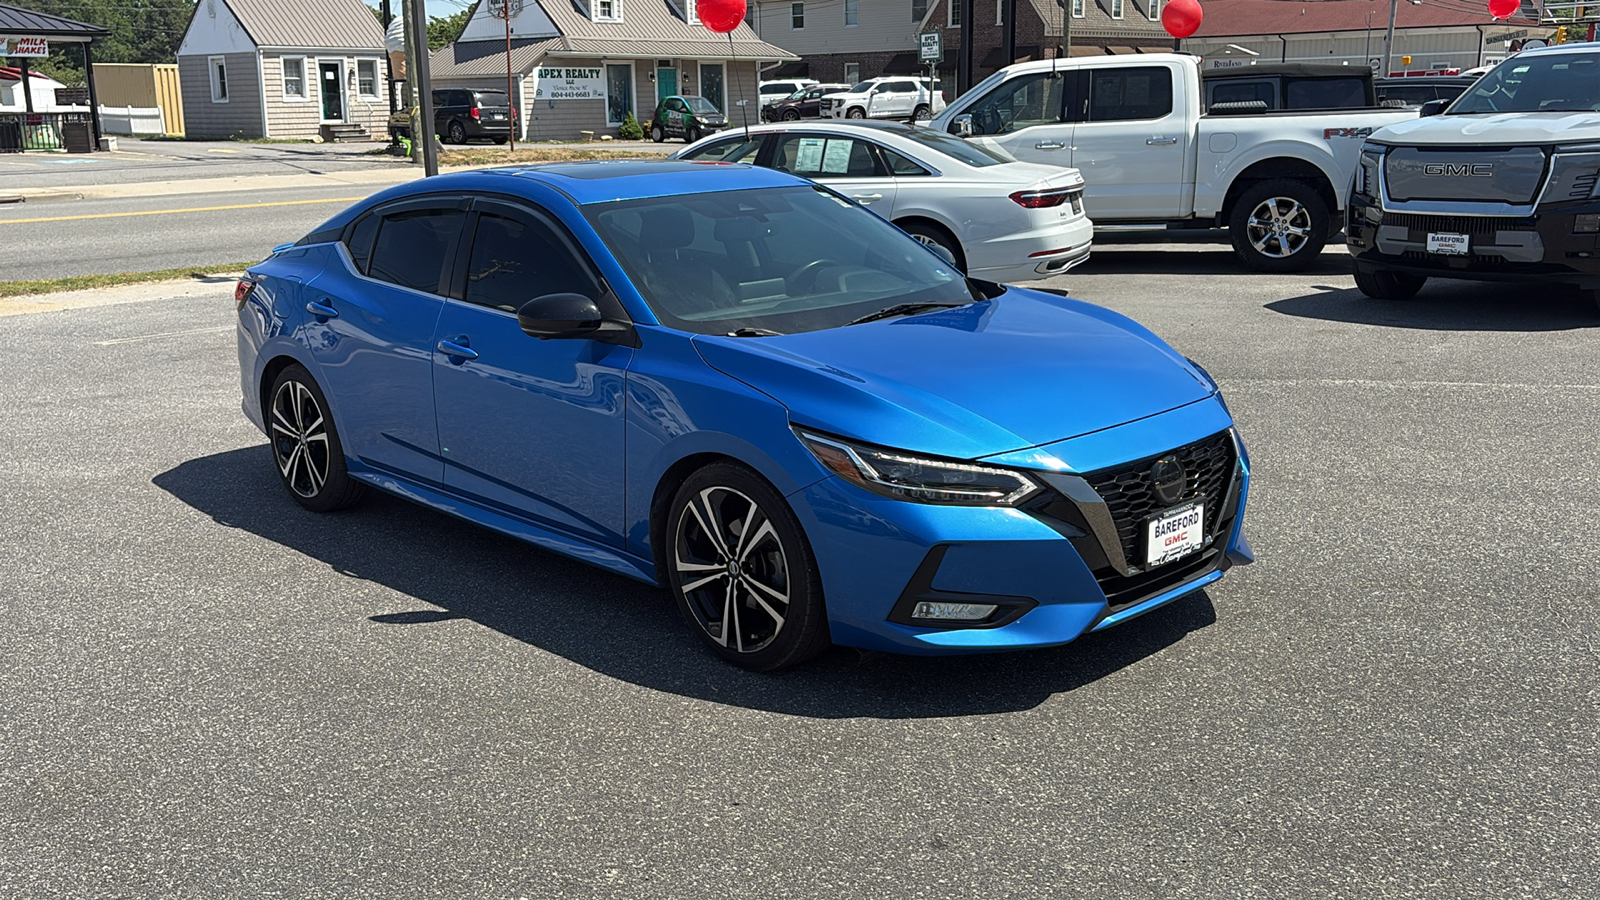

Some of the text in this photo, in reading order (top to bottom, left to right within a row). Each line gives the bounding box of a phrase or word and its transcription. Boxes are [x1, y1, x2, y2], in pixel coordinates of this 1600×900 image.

[19, 38, 46, 46] MILK
[14, 46, 46, 54] SHAKES
[538, 69, 600, 79] APEX REALTY
[1323, 127, 1372, 139] FX4
[1424, 163, 1492, 177] GMC
[1155, 512, 1199, 539] BAREFORD
[1164, 531, 1188, 547] GMC
